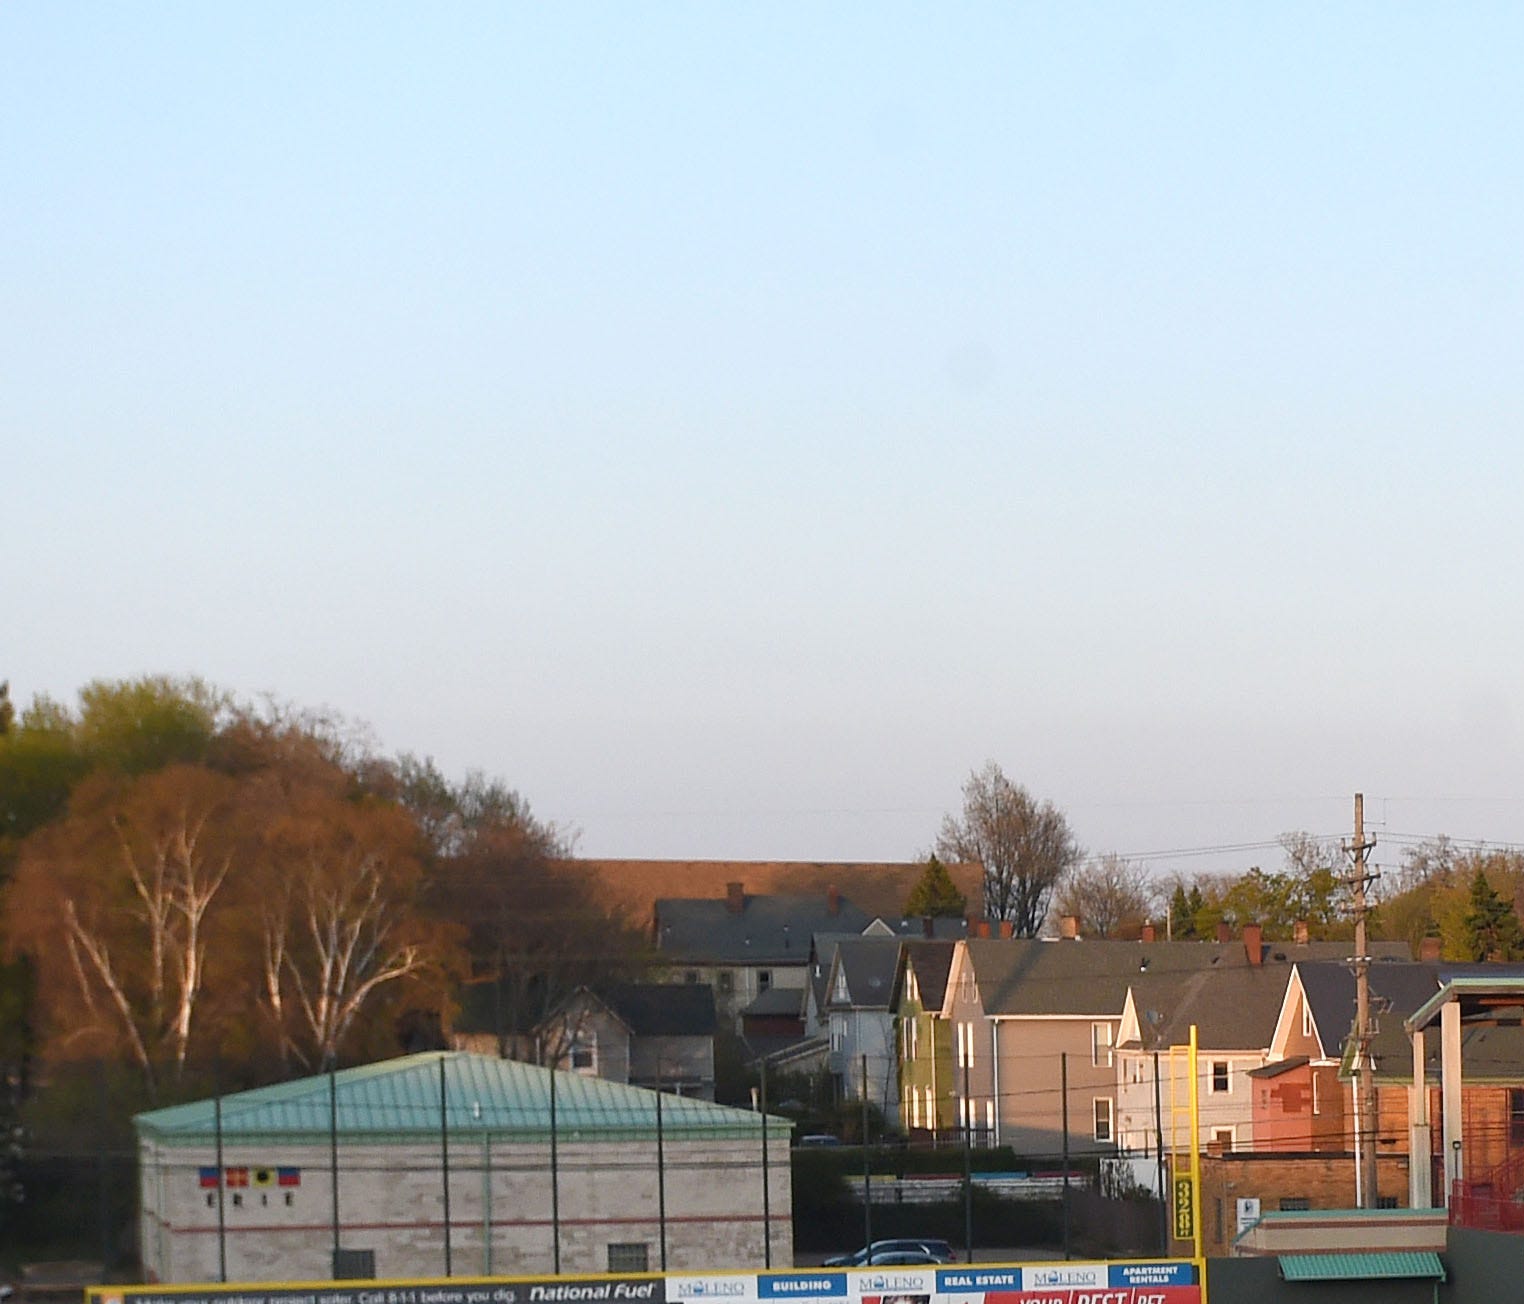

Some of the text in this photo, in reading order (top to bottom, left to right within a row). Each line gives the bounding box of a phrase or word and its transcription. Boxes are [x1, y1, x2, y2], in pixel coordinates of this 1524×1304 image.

[207, 1192, 294, 1209] ERIE
[1123, 1265, 1178, 1277] APARTMENT
[944, 1274, 1015, 1287] REAL ESTATE
[1129, 1274, 1169, 1284] RENTALS
[614, 1282, 654, 1299] Fuel
[772, 1280, 832, 1292] BUILDING
[420, 1289, 462, 1304] before
